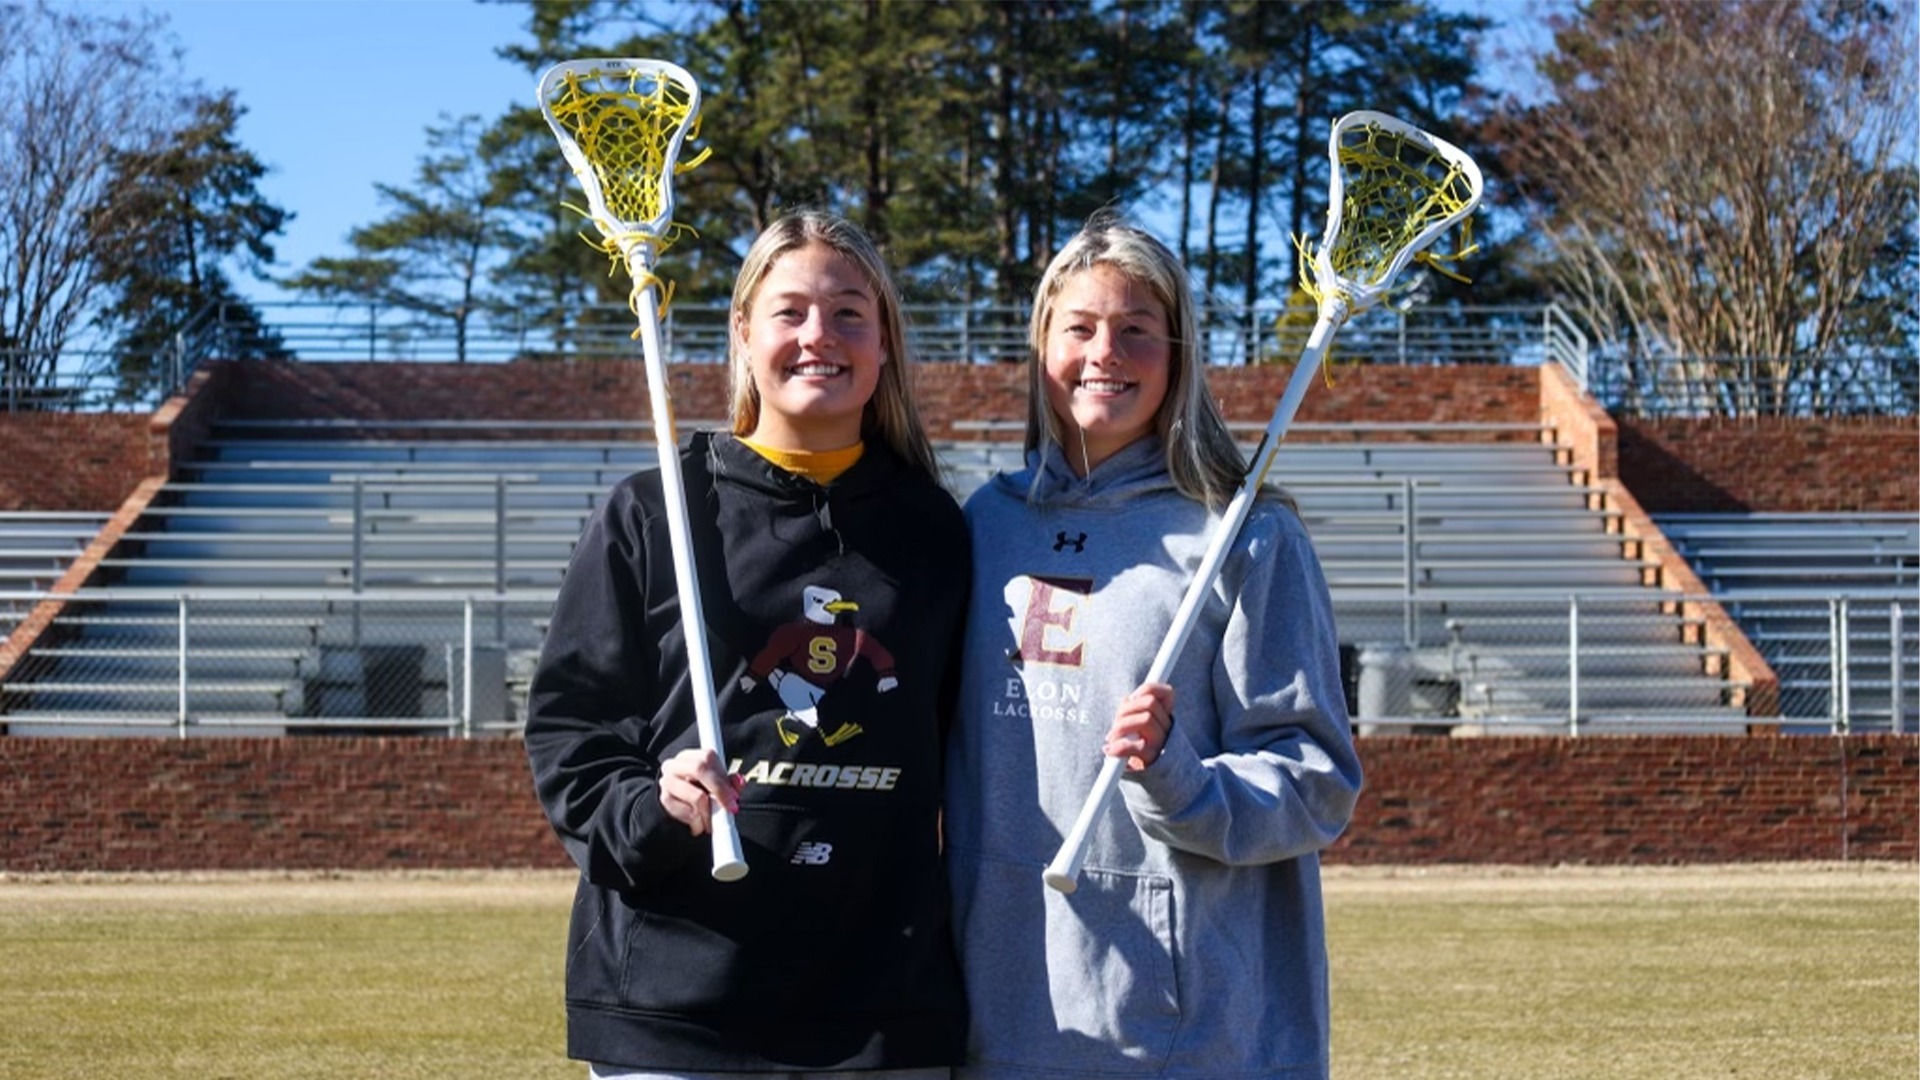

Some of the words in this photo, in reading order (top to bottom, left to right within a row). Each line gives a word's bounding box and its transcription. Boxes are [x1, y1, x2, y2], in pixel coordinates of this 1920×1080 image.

[1010, 574, 1094, 668] E
[808, 636, 837, 673] S
[993, 701, 1090, 724] LACROSSE
